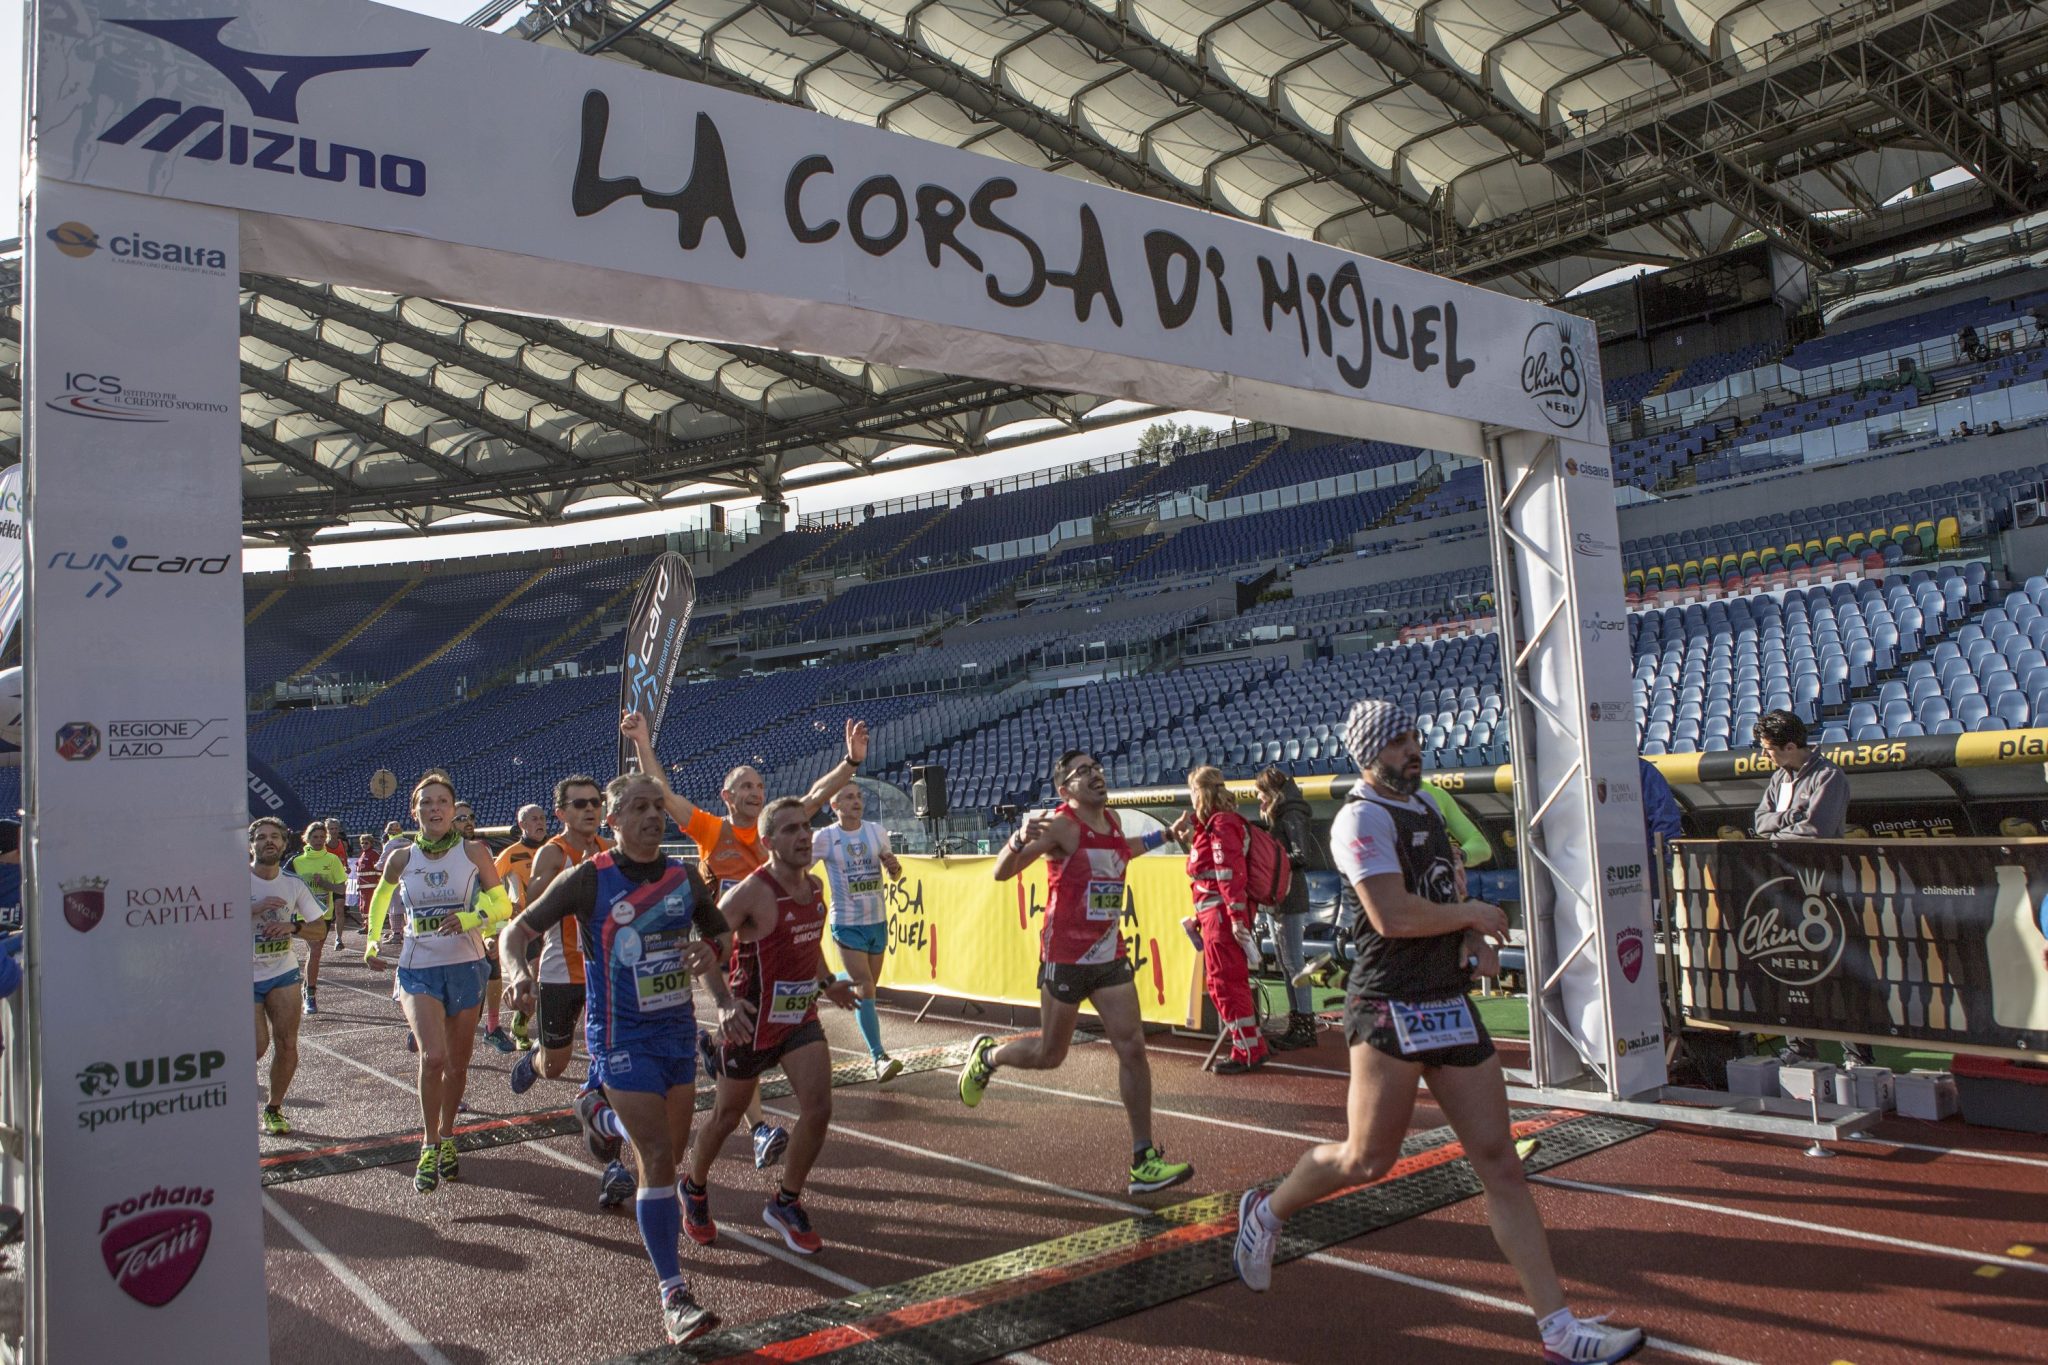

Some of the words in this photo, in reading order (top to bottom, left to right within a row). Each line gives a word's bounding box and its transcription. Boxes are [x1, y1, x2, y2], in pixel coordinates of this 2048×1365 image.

[572, 88, 747, 259] LA
[784, 154, 1123, 327] CORSA
[110, 233, 226, 269] cisalfa
[65, 372, 122, 395] ICS
[123, 390, 162, 400] ISTITUTO
[163, 392, 177, 400] PER
[124, 397, 174, 408] CREDITO
[176, 402, 228, 414] SPORTIVO
[1546, 400, 1576, 415] NERI
[109, 722, 188, 738] REGIONE
[109, 742, 163, 757] LAZIO
[1873, 818, 1918, 838] planet
[1923, 816, 1952, 828] win
[847, 859, 872, 867] LAZIO
[1616, 863, 1641, 880] UISP
[422, 888, 455, 899] LAZIO
[852, 880, 878, 892] 1087
[1922, 885, 1976, 896] chin8neri.it
[126, 885, 200, 908] ROMA
[126, 902, 234, 928] CAPITALE
[259, 941, 289, 954] 1122
[1772, 956, 1819, 971] NERI
[652, 971, 686, 993] 507
[1405, 1010, 1461, 1033] 2677
[125, 1050, 226, 1088] UISP
[1824, 1080, 1831, 1095] 8
[1882, 1083, 1889, 1099] 3
[78, 1084, 227, 1132] sportpertutti
[99, 1185, 214, 1234] Forhans
